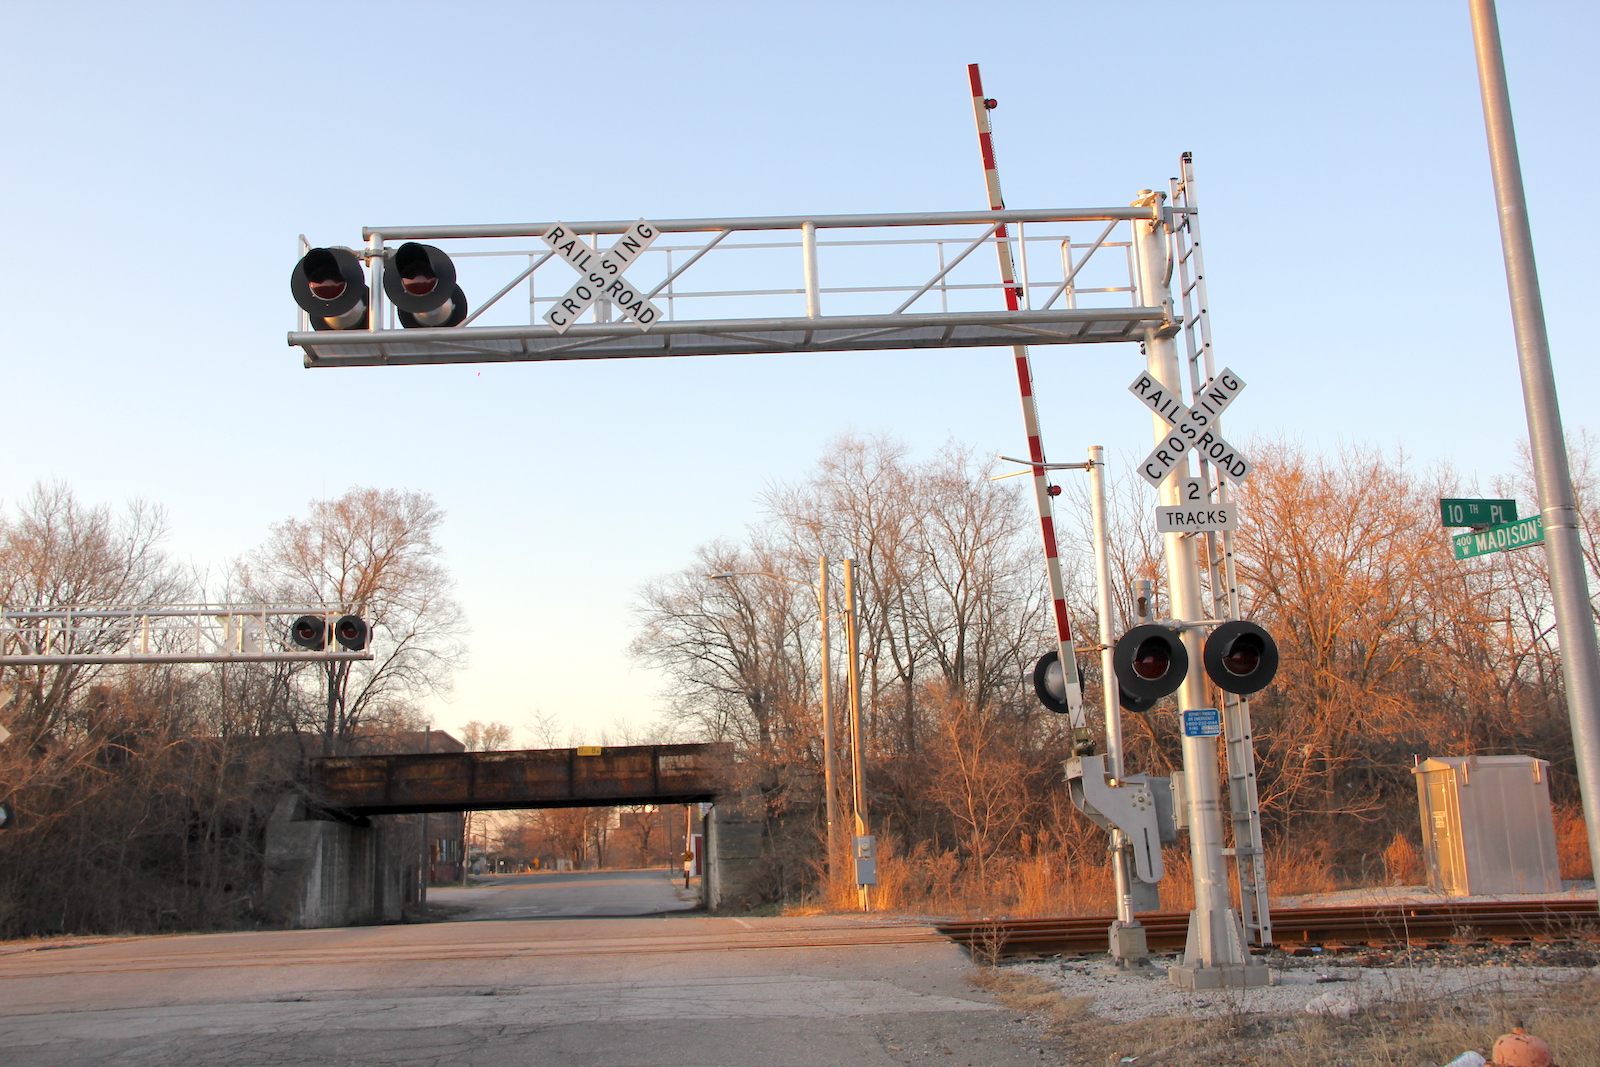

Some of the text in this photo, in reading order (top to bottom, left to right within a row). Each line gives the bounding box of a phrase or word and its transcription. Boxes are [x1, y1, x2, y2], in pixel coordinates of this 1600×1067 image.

[547, 226, 592, 272] RAIL
[550, 223, 653, 326] CROSSING
[1134, 376, 1179, 424] RAIL
[1145, 375, 1238, 480] CROSSING
[1187, 482, 1200, 500] 2
[1166, 510, 1227, 526] TRACKS
[1490, 504, 1508, 524] PL
[1456, 536, 1472, 547] 400
[1475, 518, 1542, 553] MADISON S
[1461, 546, 1469, 556] W
